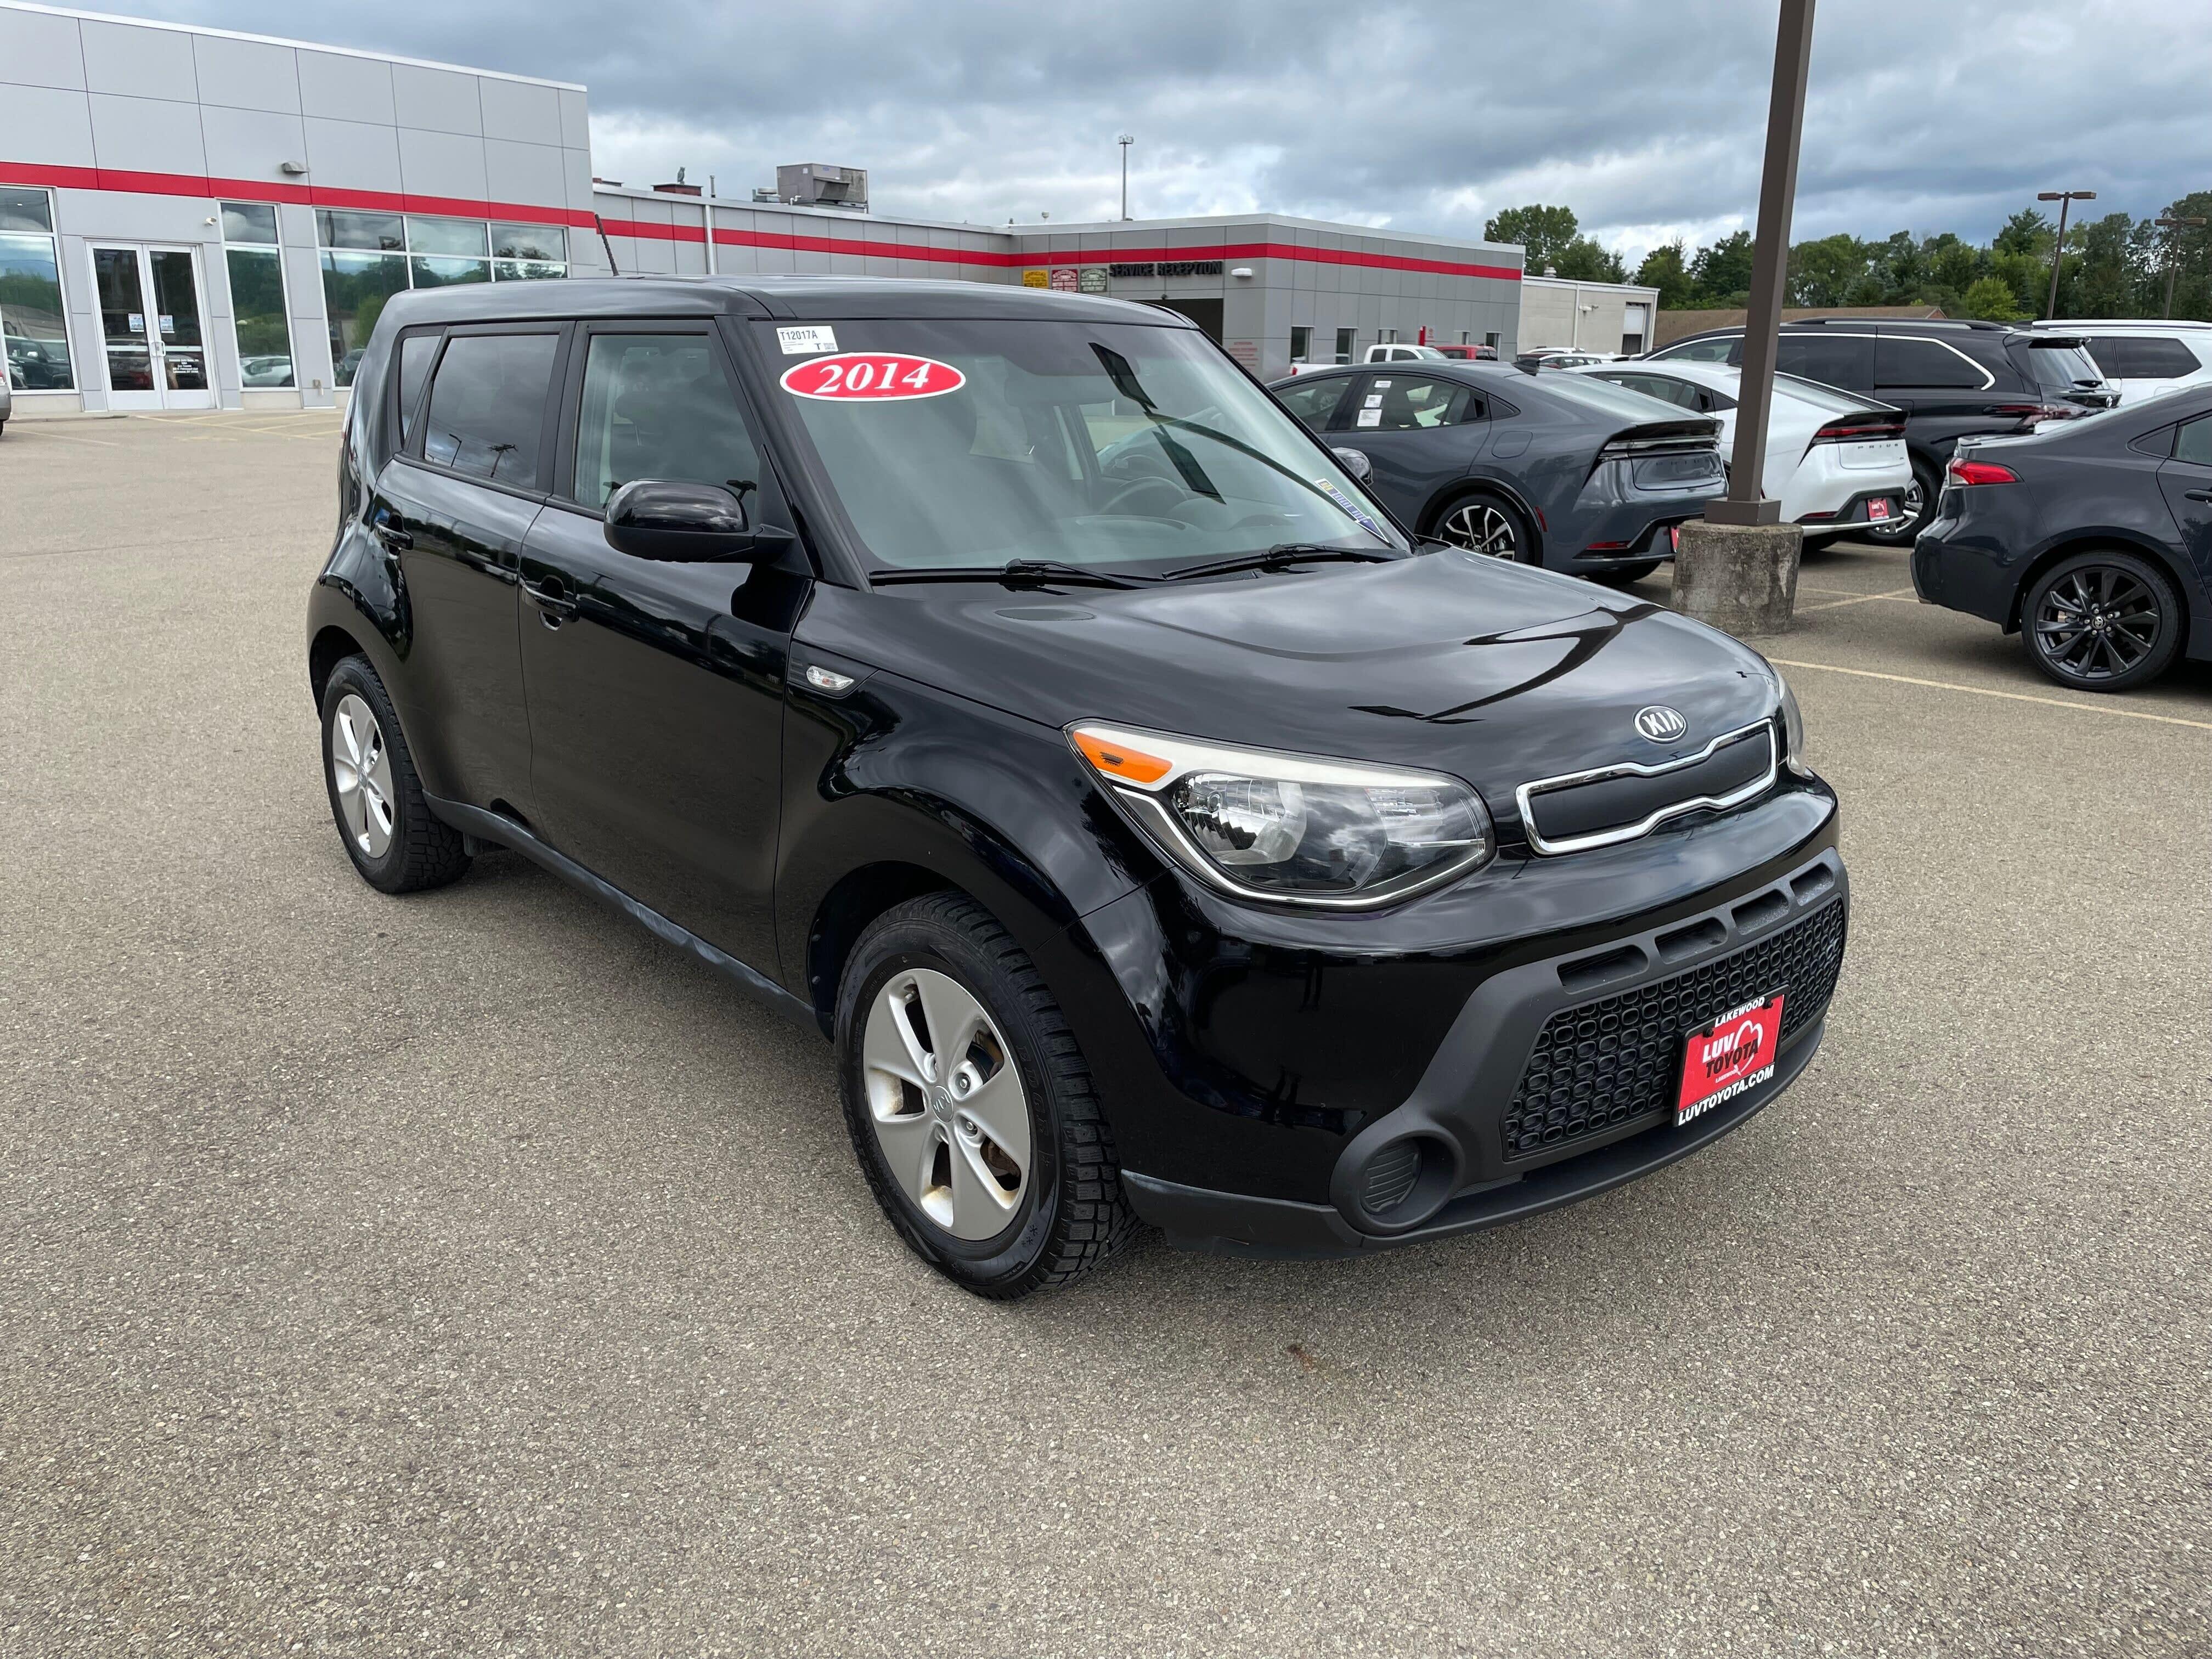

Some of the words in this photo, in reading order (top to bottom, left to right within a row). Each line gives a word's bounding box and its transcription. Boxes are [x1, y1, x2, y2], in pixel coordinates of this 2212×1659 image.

[1109, 263, 1154, 276] SERVICE
[1157, 261, 1223, 276] RECEPTION
[780, 330, 818, 341] T12017A
[814, 362, 931, 393] 2014
[1641, 710, 1684, 736] KIA
[1714, 997, 1765, 1028] LAKEWOOD
[1702, 1031, 1735, 1063] LUV
[1706, 1039, 1758, 1078] TOYOTA
[1678, 1064, 1775, 1126] LUVTOYOTA.COM
